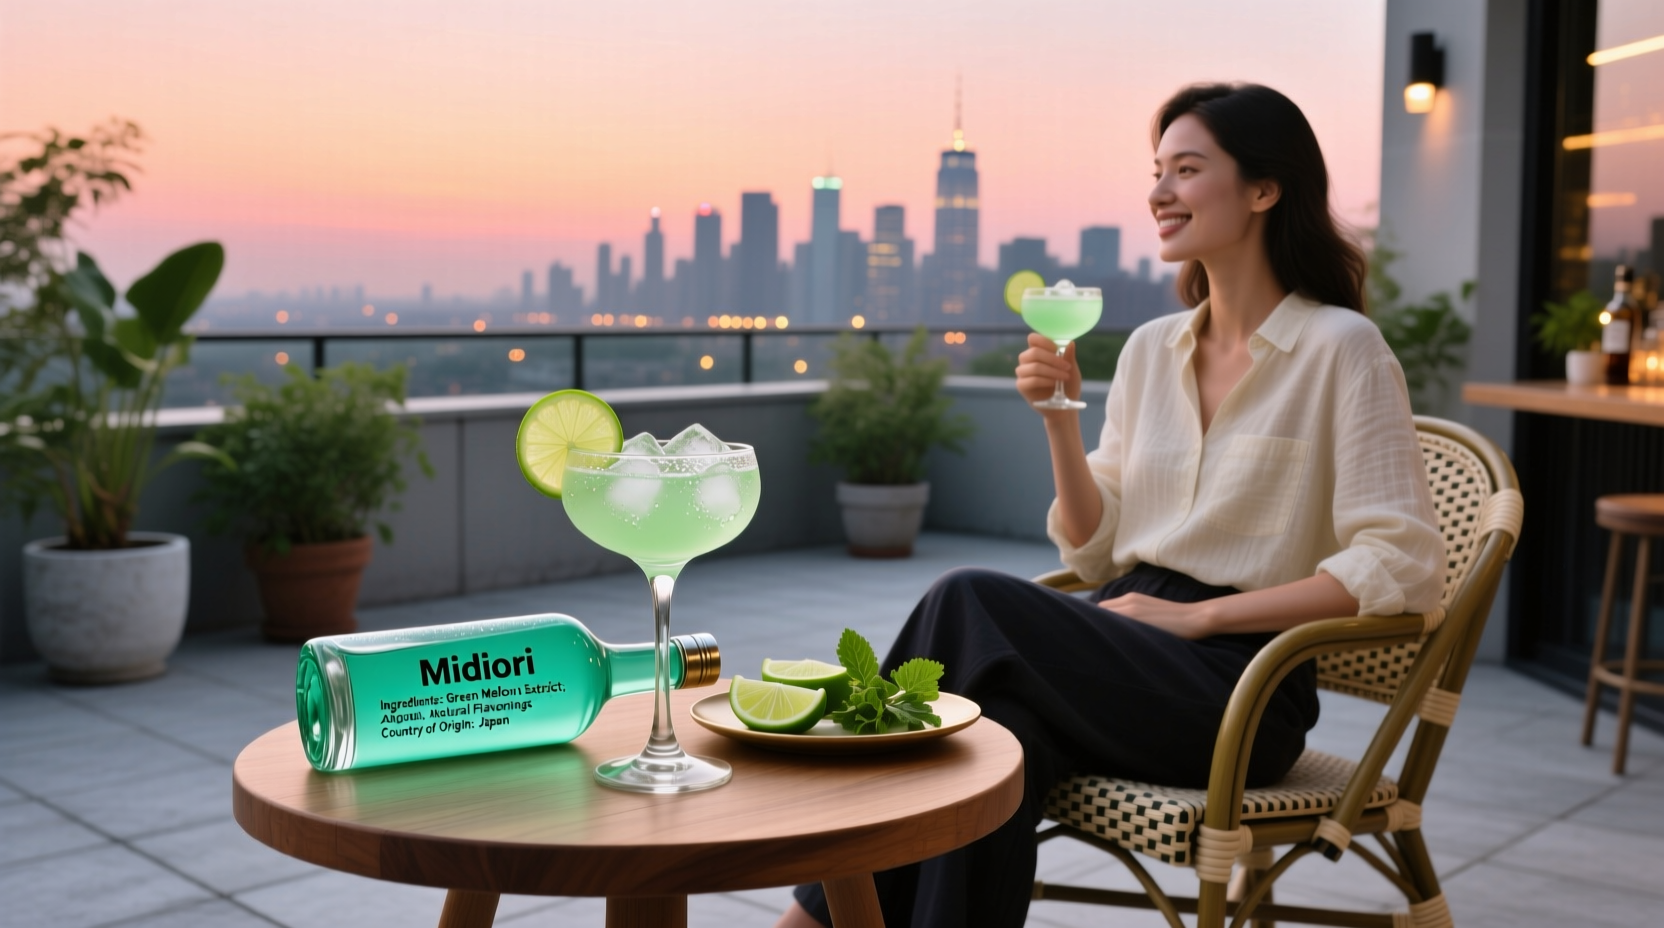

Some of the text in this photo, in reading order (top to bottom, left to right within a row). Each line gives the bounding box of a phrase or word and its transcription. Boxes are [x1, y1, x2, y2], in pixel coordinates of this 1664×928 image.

[419, 647, 535, 686] Midiori
[446, 692, 479, 703] Green
[381, 725, 424, 738] Country
[425, 722, 437, 734] of
